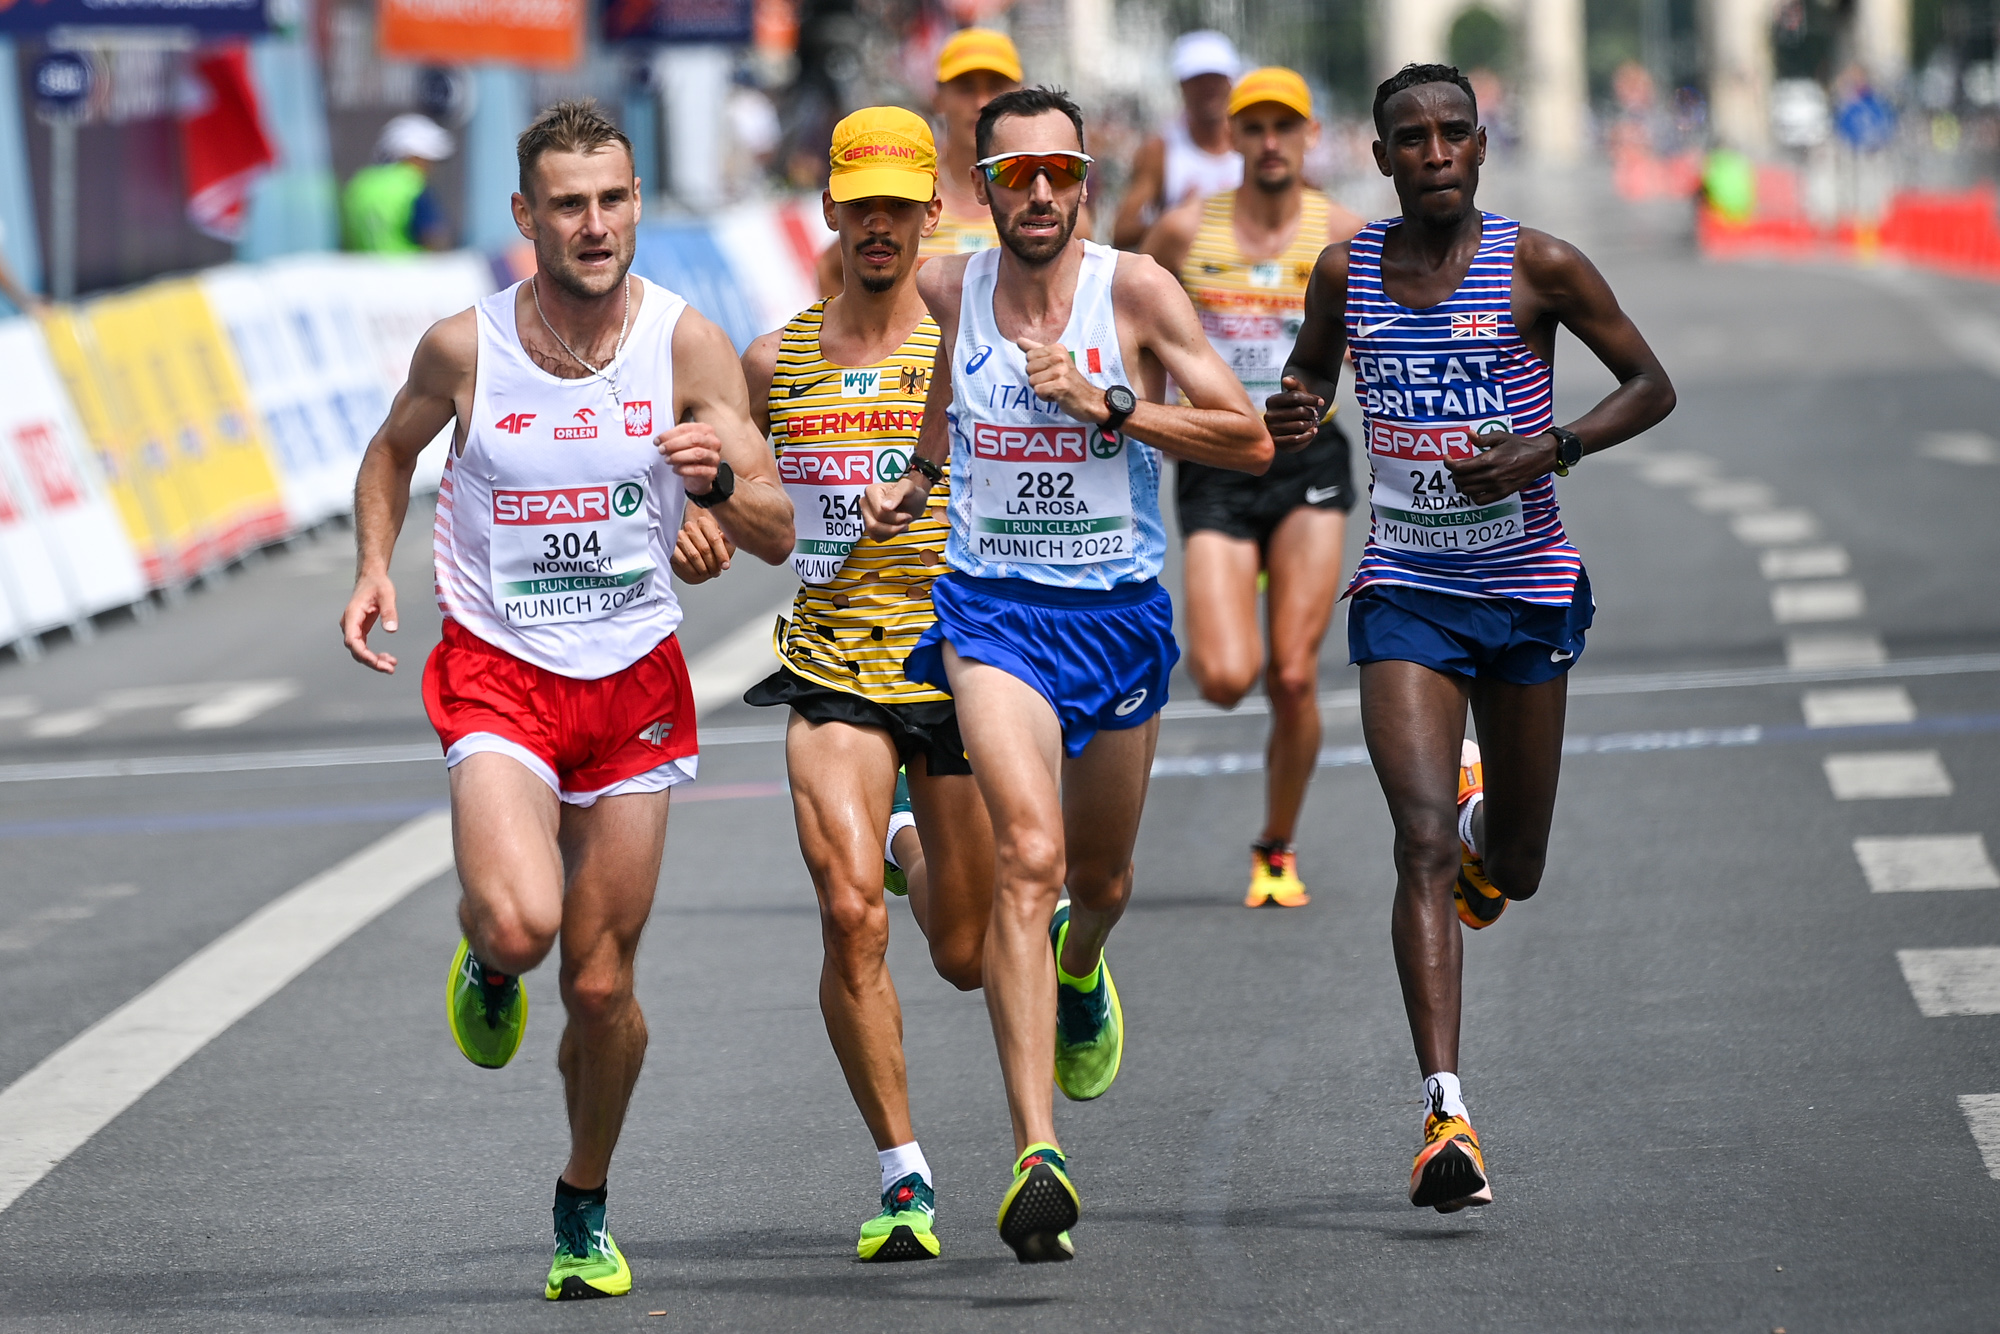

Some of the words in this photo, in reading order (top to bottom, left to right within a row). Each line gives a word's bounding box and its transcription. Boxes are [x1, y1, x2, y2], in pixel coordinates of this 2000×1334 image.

[844, 145, 916, 161] GERMANY
[1359, 355, 1497, 384] GREAT
[989, 384, 1059, 414] ITAL
[1367, 385, 1505, 417] BRITAIN
[495, 413, 537, 434] 4F
[556, 427, 595, 439] ORLEN
[787, 410, 924, 438] GERMANY
[976, 428, 1083, 457] SPAR
[1373, 427, 1470, 456] SPAR
[779, 455, 871, 480] SPAR
[1016, 472, 1075, 499] 282
[495, 491, 607, 521] SPAR
[819, 494, 862, 520] 254
[1006, 501, 1030, 515] LA
[1036, 501, 1089, 515] ROSA
[1411, 496, 1471, 510] AADAN
[1013, 521, 1043, 533] RUN
[1410, 513, 1435, 526] RUN
[542, 530, 602, 560] 304
[1384, 523, 1458, 548] MUNICH
[1466, 519, 1515, 546] 2022
[818, 542, 838, 554] RUN
[979, 537, 1063, 558] MUNICH
[1072, 535, 1123, 558] 2022
[533, 557, 613, 574] NOWICKI
[539, 579, 569, 593] RUN
[505, 595, 592, 621] MUNICH
[600, 582, 645, 611] 2022
[638, 721, 674, 745] 4F
